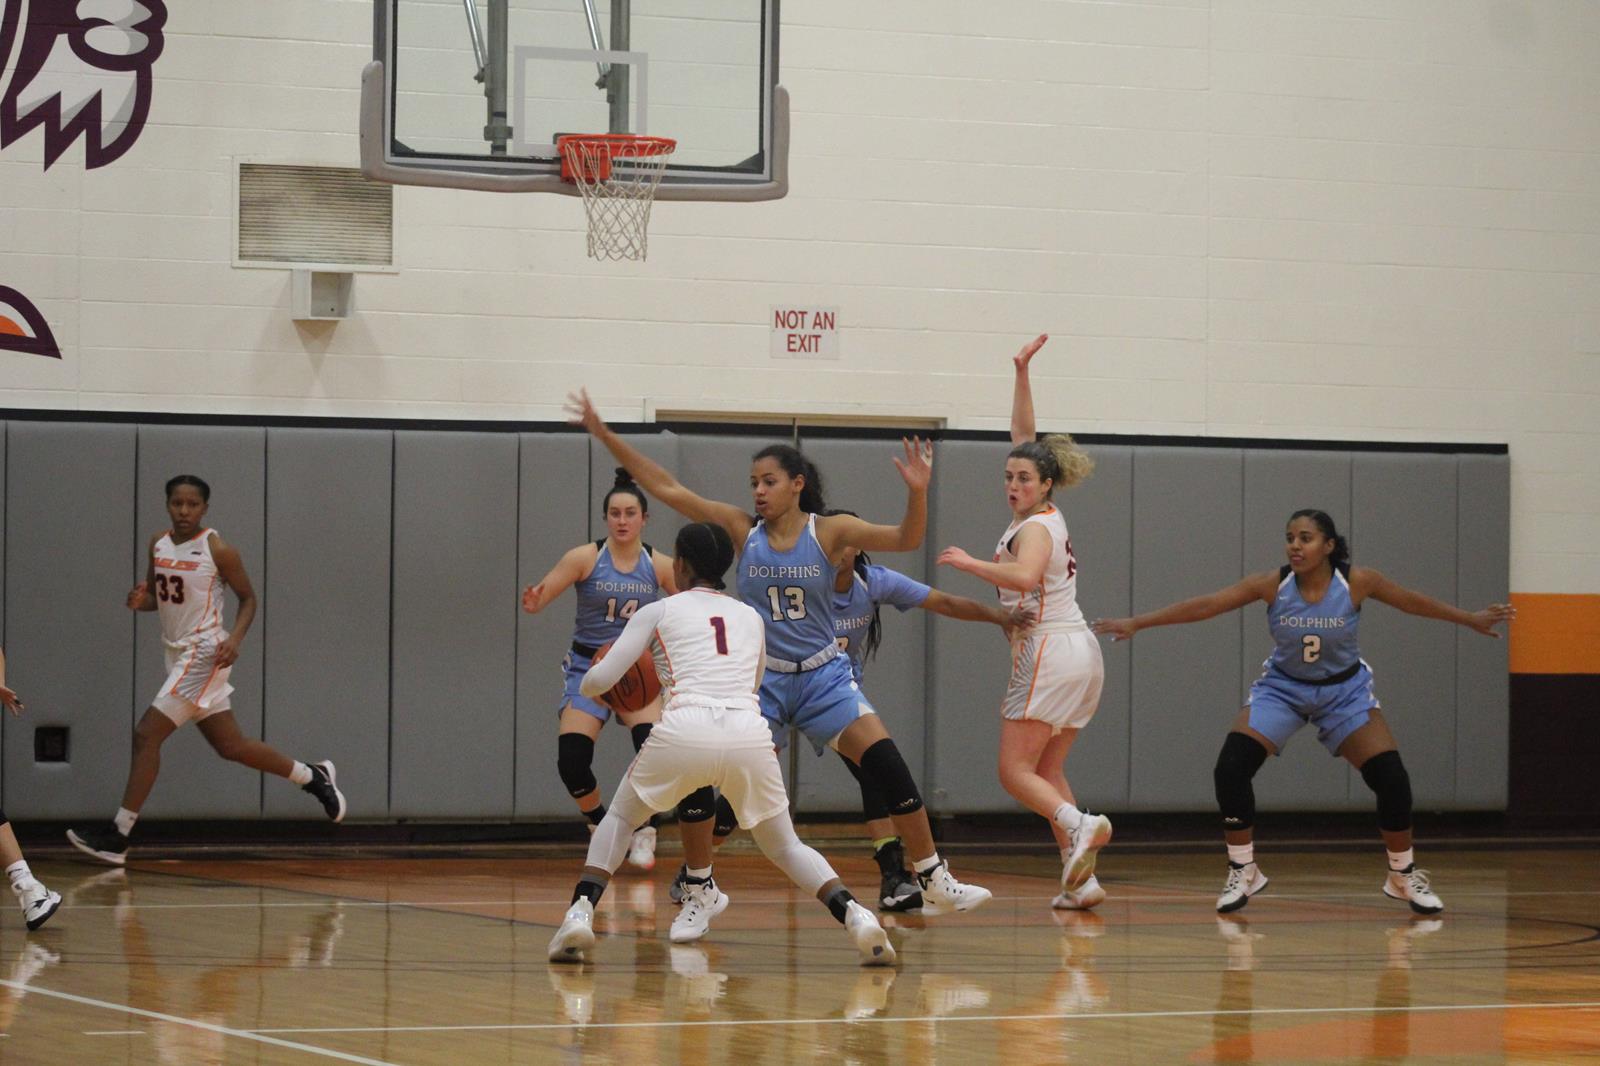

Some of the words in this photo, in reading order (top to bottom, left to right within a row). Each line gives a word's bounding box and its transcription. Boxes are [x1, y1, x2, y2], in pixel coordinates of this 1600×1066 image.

[775, 310, 807, 329] NOT
[813, 311, 834, 330] AN
[787, 333, 821, 353] EXIT
[748, 564, 821, 578] DOLPHINS
[155, 573, 185, 605] 33
[595, 581, 653, 594] DOLPHINS
[605, 597, 639, 623] 14
[767, 585, 807, 621] 13
[834, 615, 870, 630] PHINS
[1279, 615, 1345, 629] DOLPHINS
[709, 616, 728, 655] 1
[1301, 632, 1321, 664] 2
